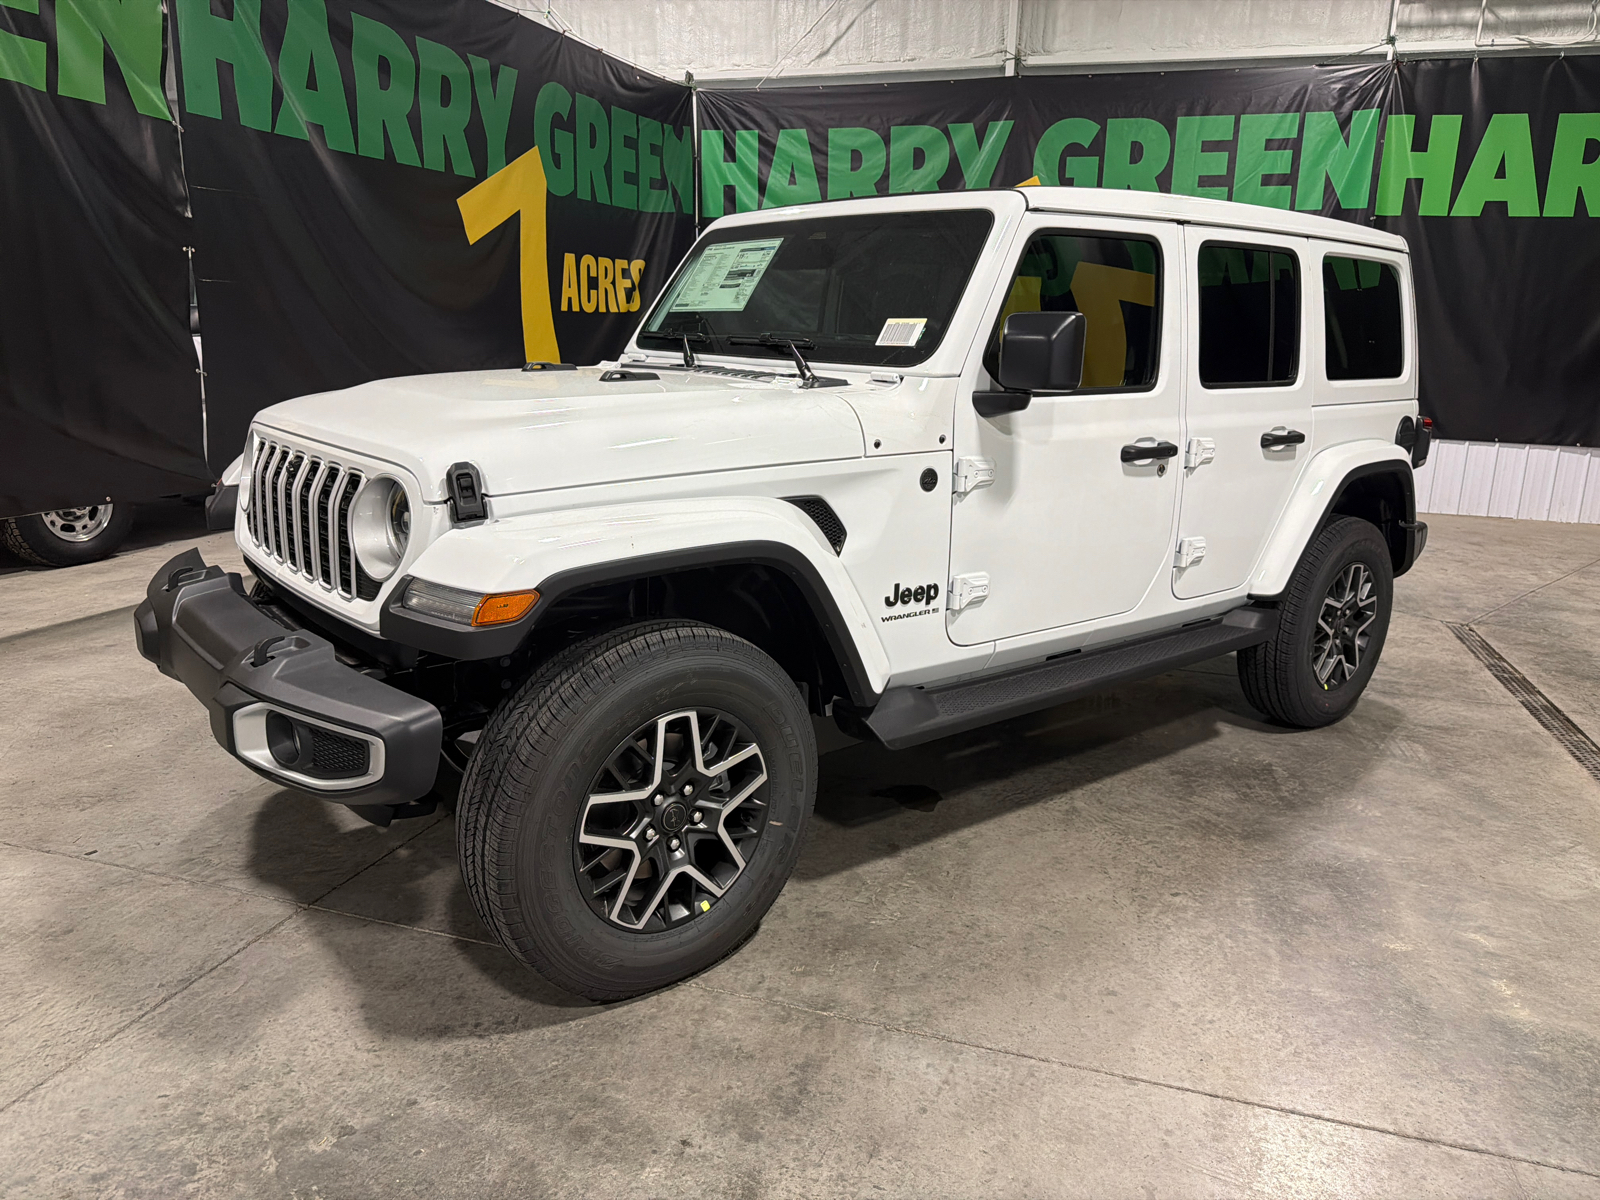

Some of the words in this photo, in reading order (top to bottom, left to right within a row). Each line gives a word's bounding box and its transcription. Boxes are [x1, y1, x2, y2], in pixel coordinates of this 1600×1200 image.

[179, 0, 519, 179] HARRY
[534, 81, 694, 216] GREEN
[701, 119, 1014, 218] HARRY
[1033, 108, 1381, 211] GREEN
[560, 252, 646, 313] ACRES
[880, 608, 931, 623] WRANGLER
[884, 582, 940, 607] Jeep
